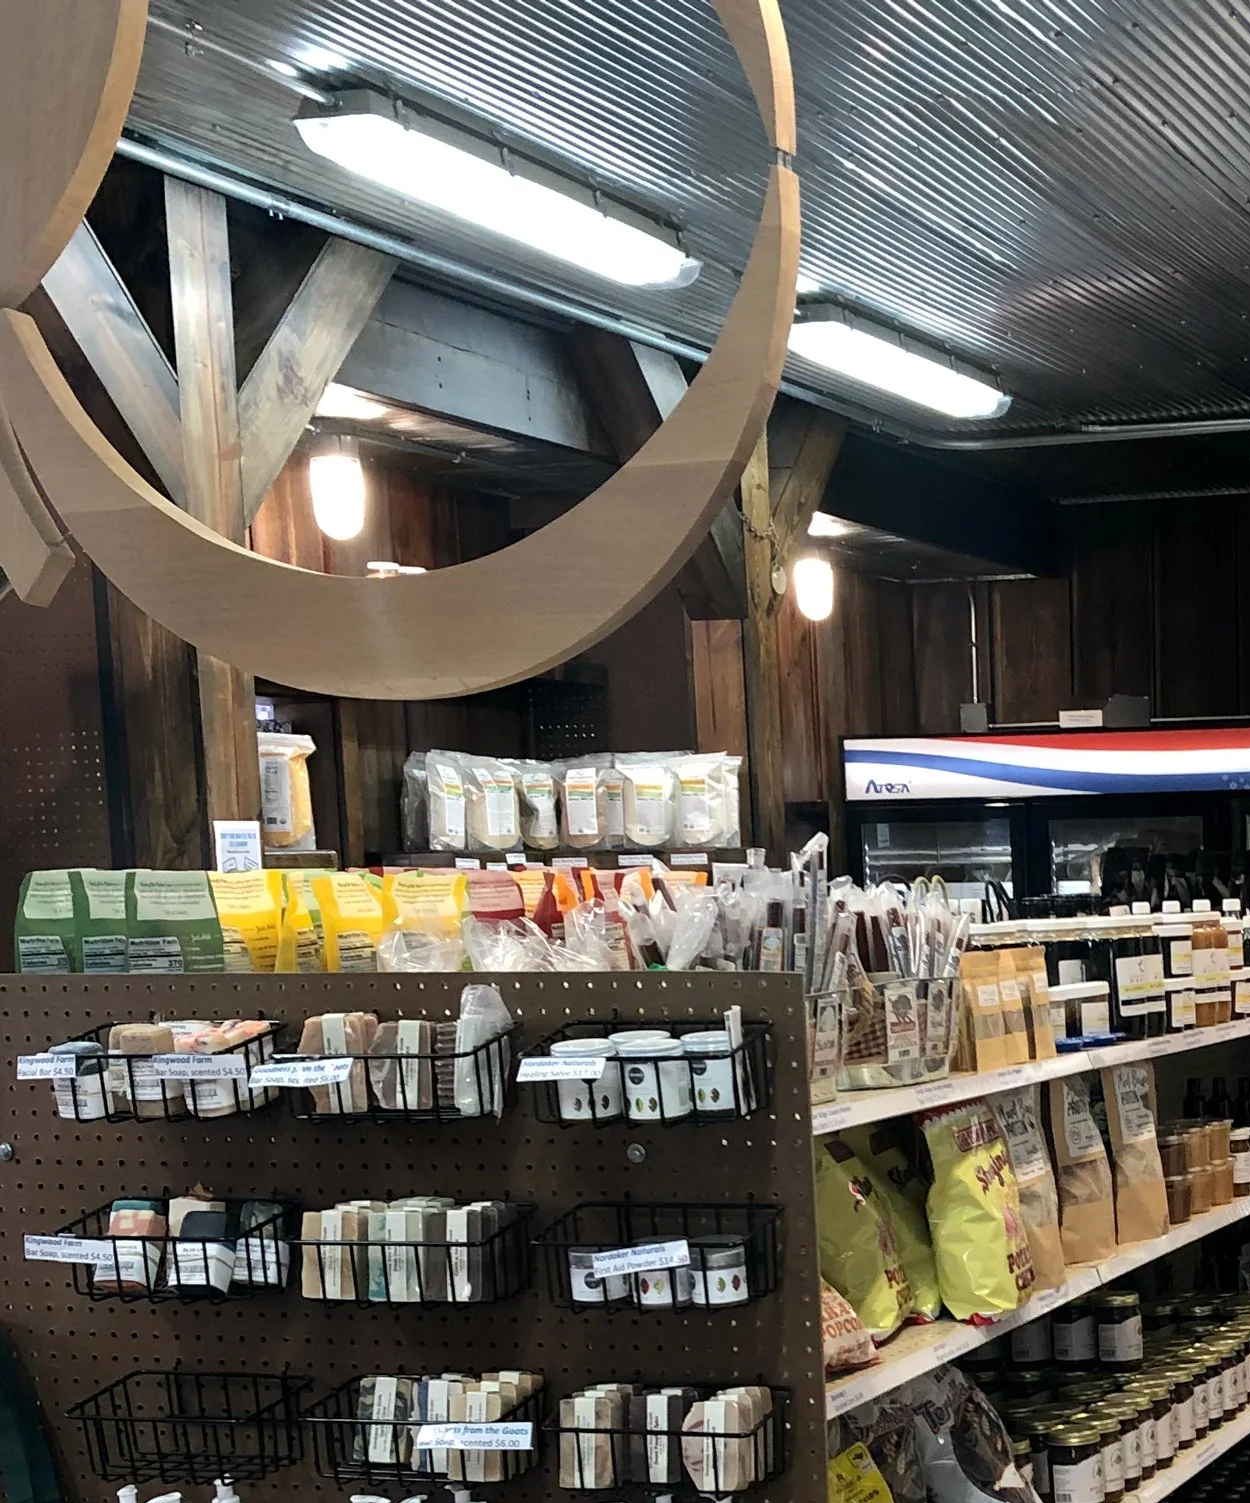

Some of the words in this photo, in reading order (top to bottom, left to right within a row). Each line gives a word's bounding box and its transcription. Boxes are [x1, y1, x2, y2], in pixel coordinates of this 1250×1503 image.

[154, 1055, 190, 1065] Kingwood
[192, 1056, 212, 1064] Farm
[155, 1068, 168, 1076] Bar
[191, 1068, 221, 1076] scented
[223, 1067, 245, 1076] $4.50
[631, 1245, 666, 1256] Naturals
[61, 1251, 88, 1260] scented
[613, 1262, 625, 1270] Aid
[627, 1260, 656, 1269] Powder
[462, 1426, 484, 1435] from
[485, 1426, 500, 1434] the
[502, 1427, 528, 1435] Goats
[495, 1439, 520, 1448] $6.00
